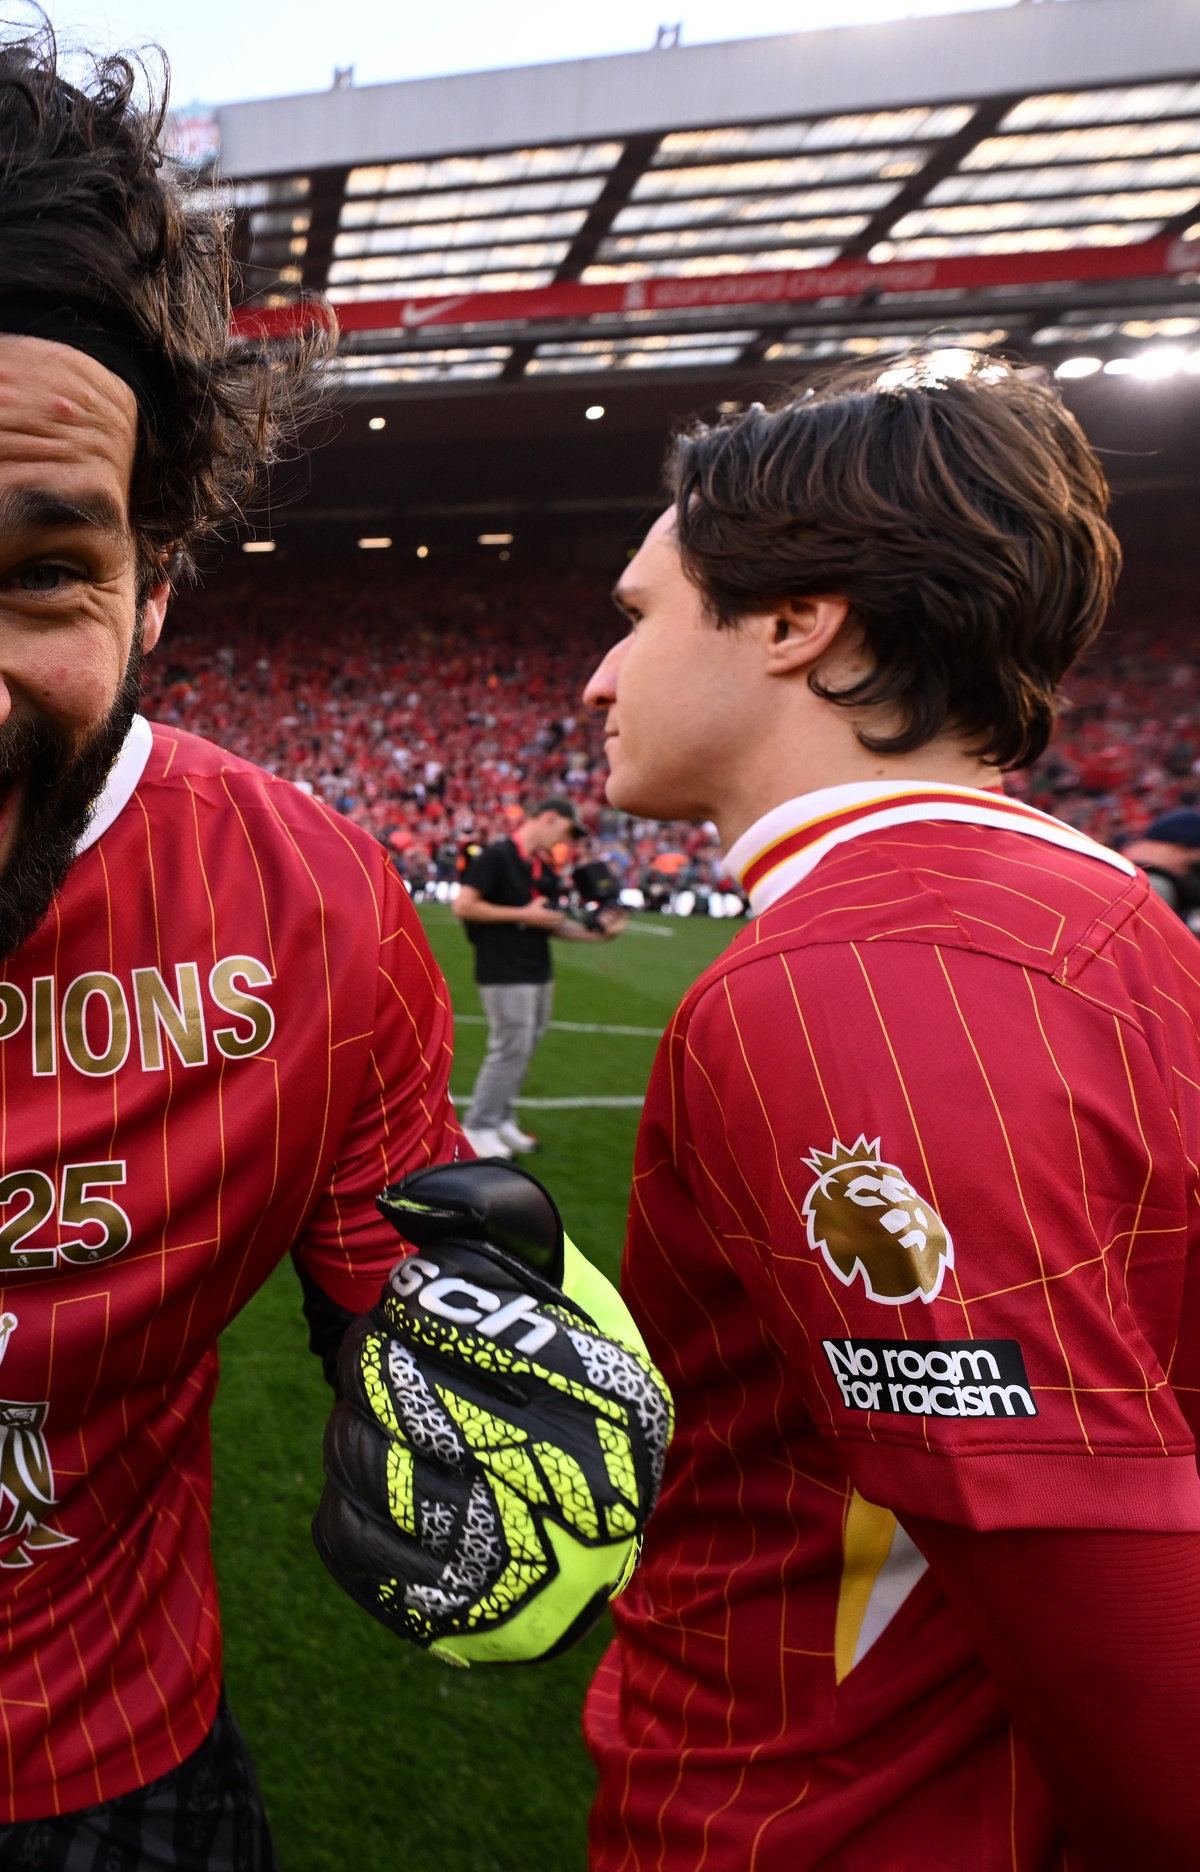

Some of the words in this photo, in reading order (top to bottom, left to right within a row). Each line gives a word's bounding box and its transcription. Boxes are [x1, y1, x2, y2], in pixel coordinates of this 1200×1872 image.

[389, 1255, 557, 1356] sch
[822, 1340, 878, 1377] No
[882, 1349, 1001, 1381] room
[836, 1373, 883, 1409] for
[888, 1376, 1037, 1417] racism
